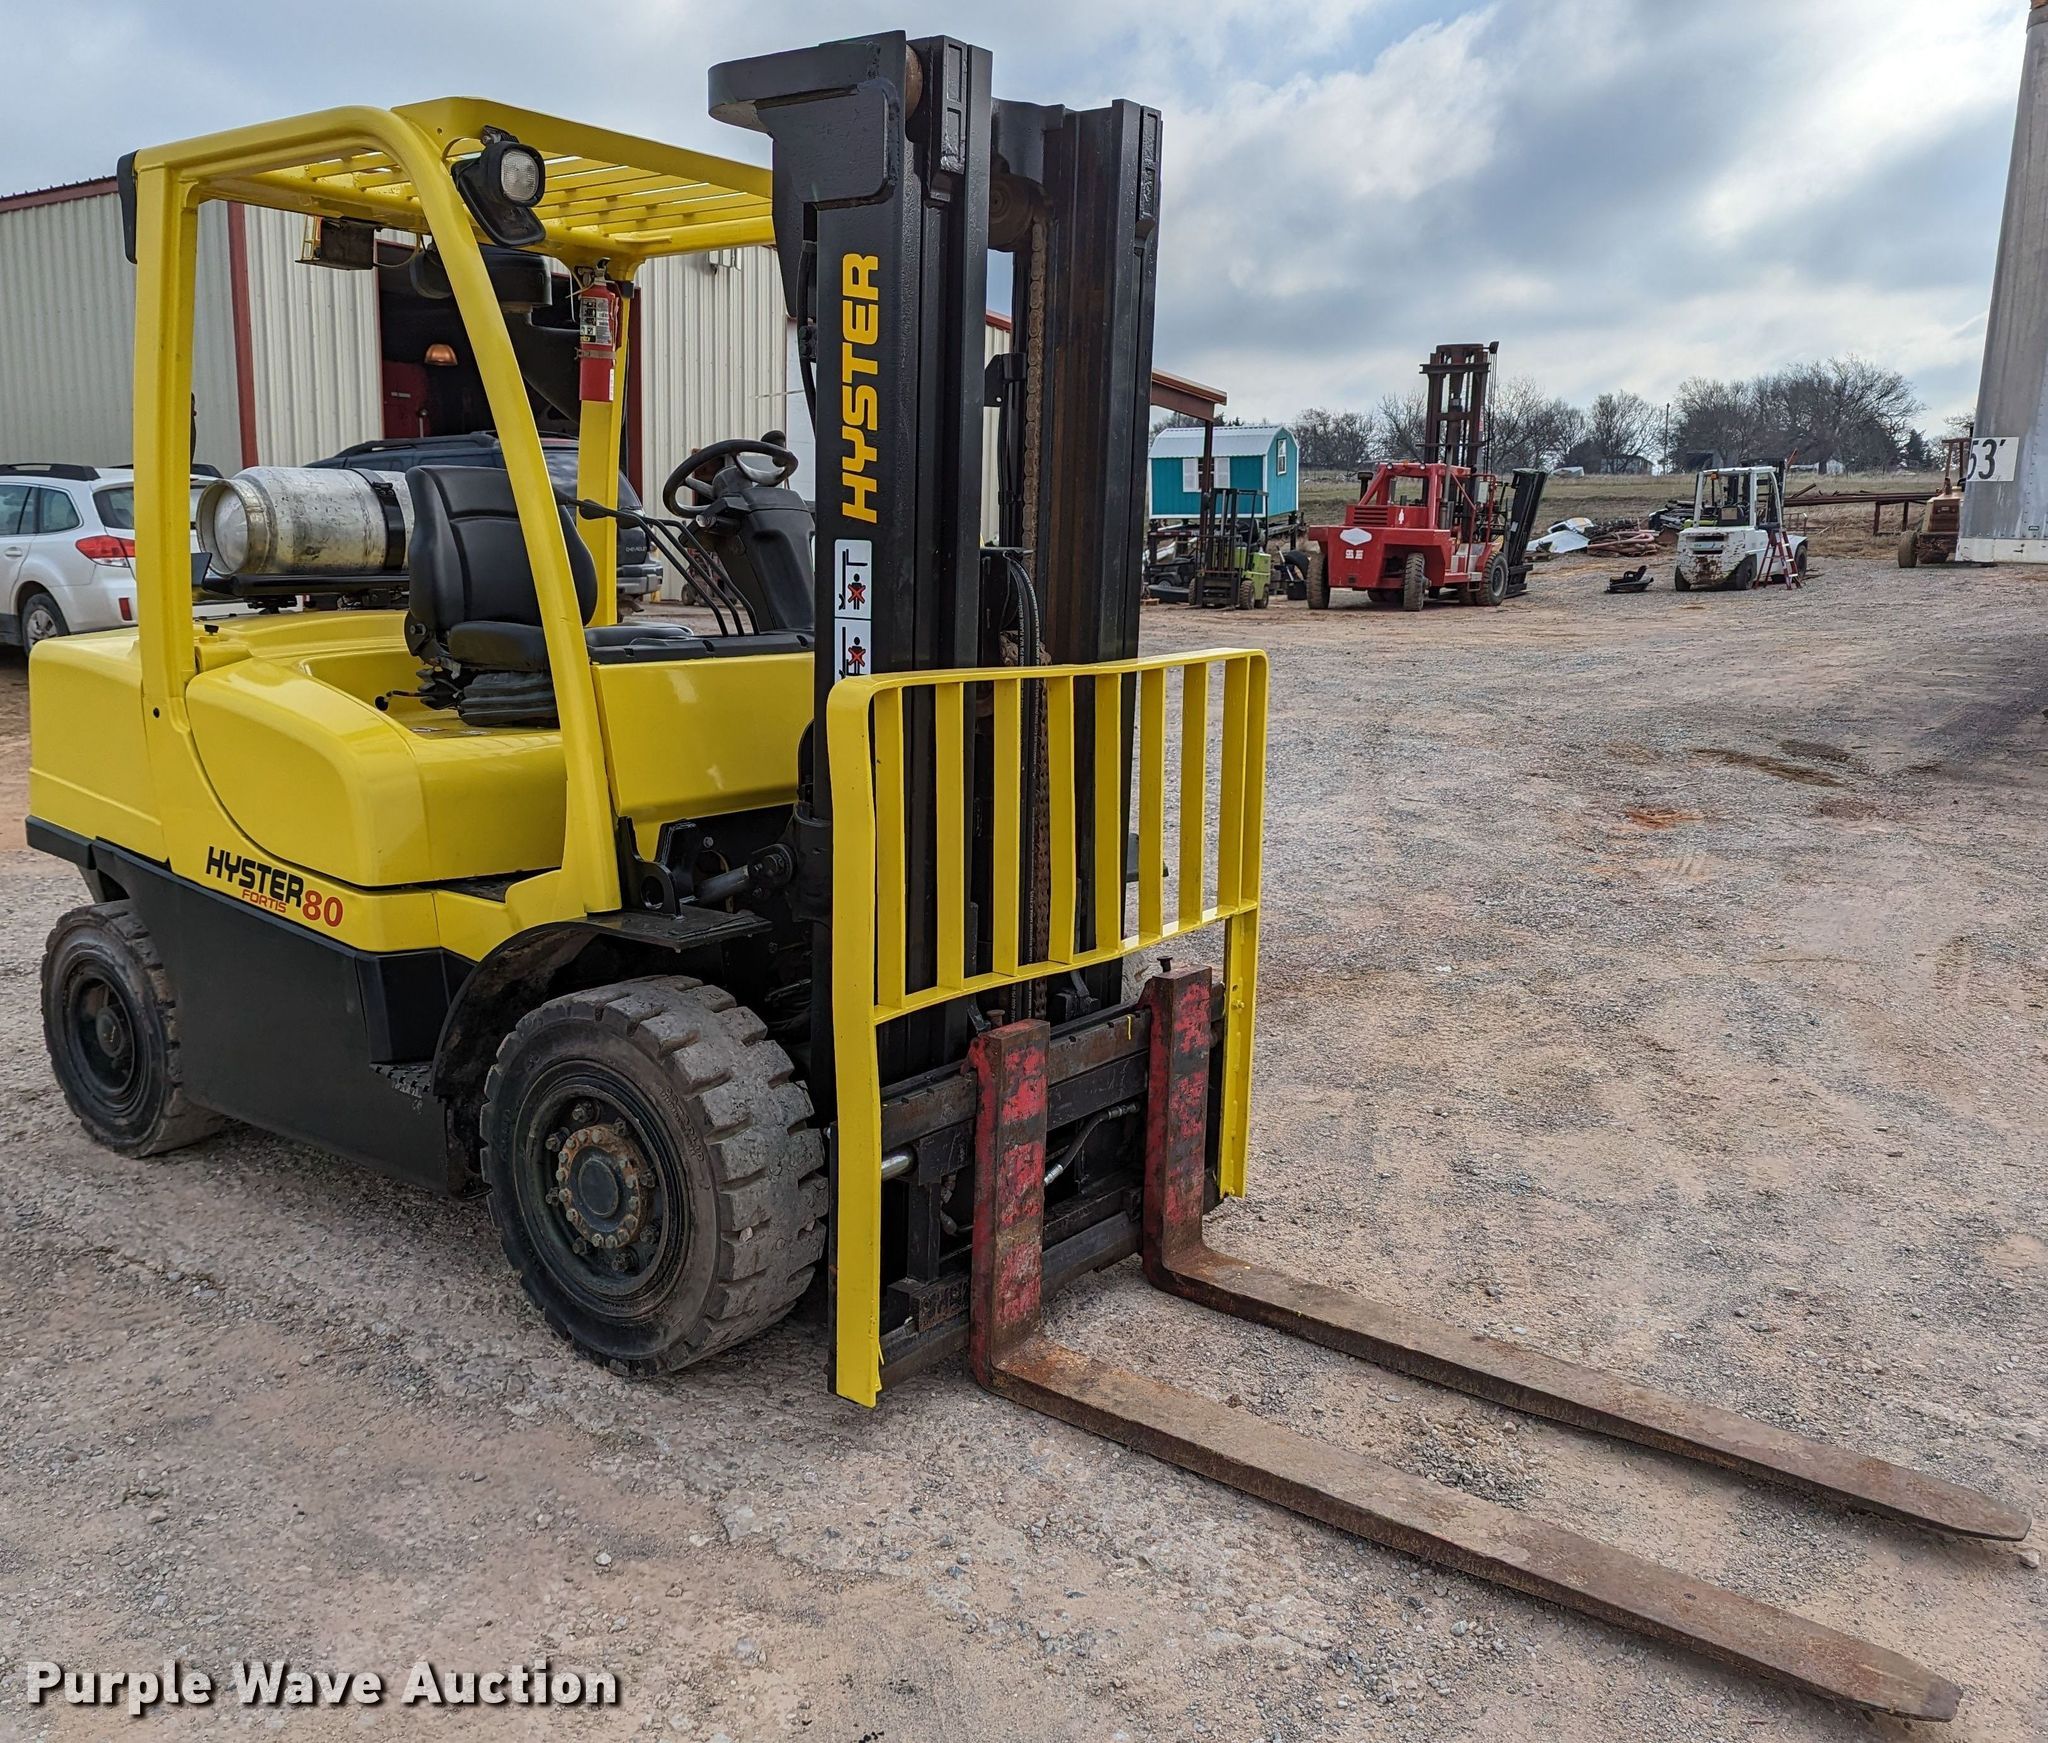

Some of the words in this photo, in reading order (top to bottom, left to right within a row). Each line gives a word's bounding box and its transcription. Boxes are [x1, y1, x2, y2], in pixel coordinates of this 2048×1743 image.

[842, 253, 878, 524] HYSTER
[206, 846, 304, 908] HYSTER
[302, 890, 343, 928] 80
[242, 889, 287, 913] FORTIS
